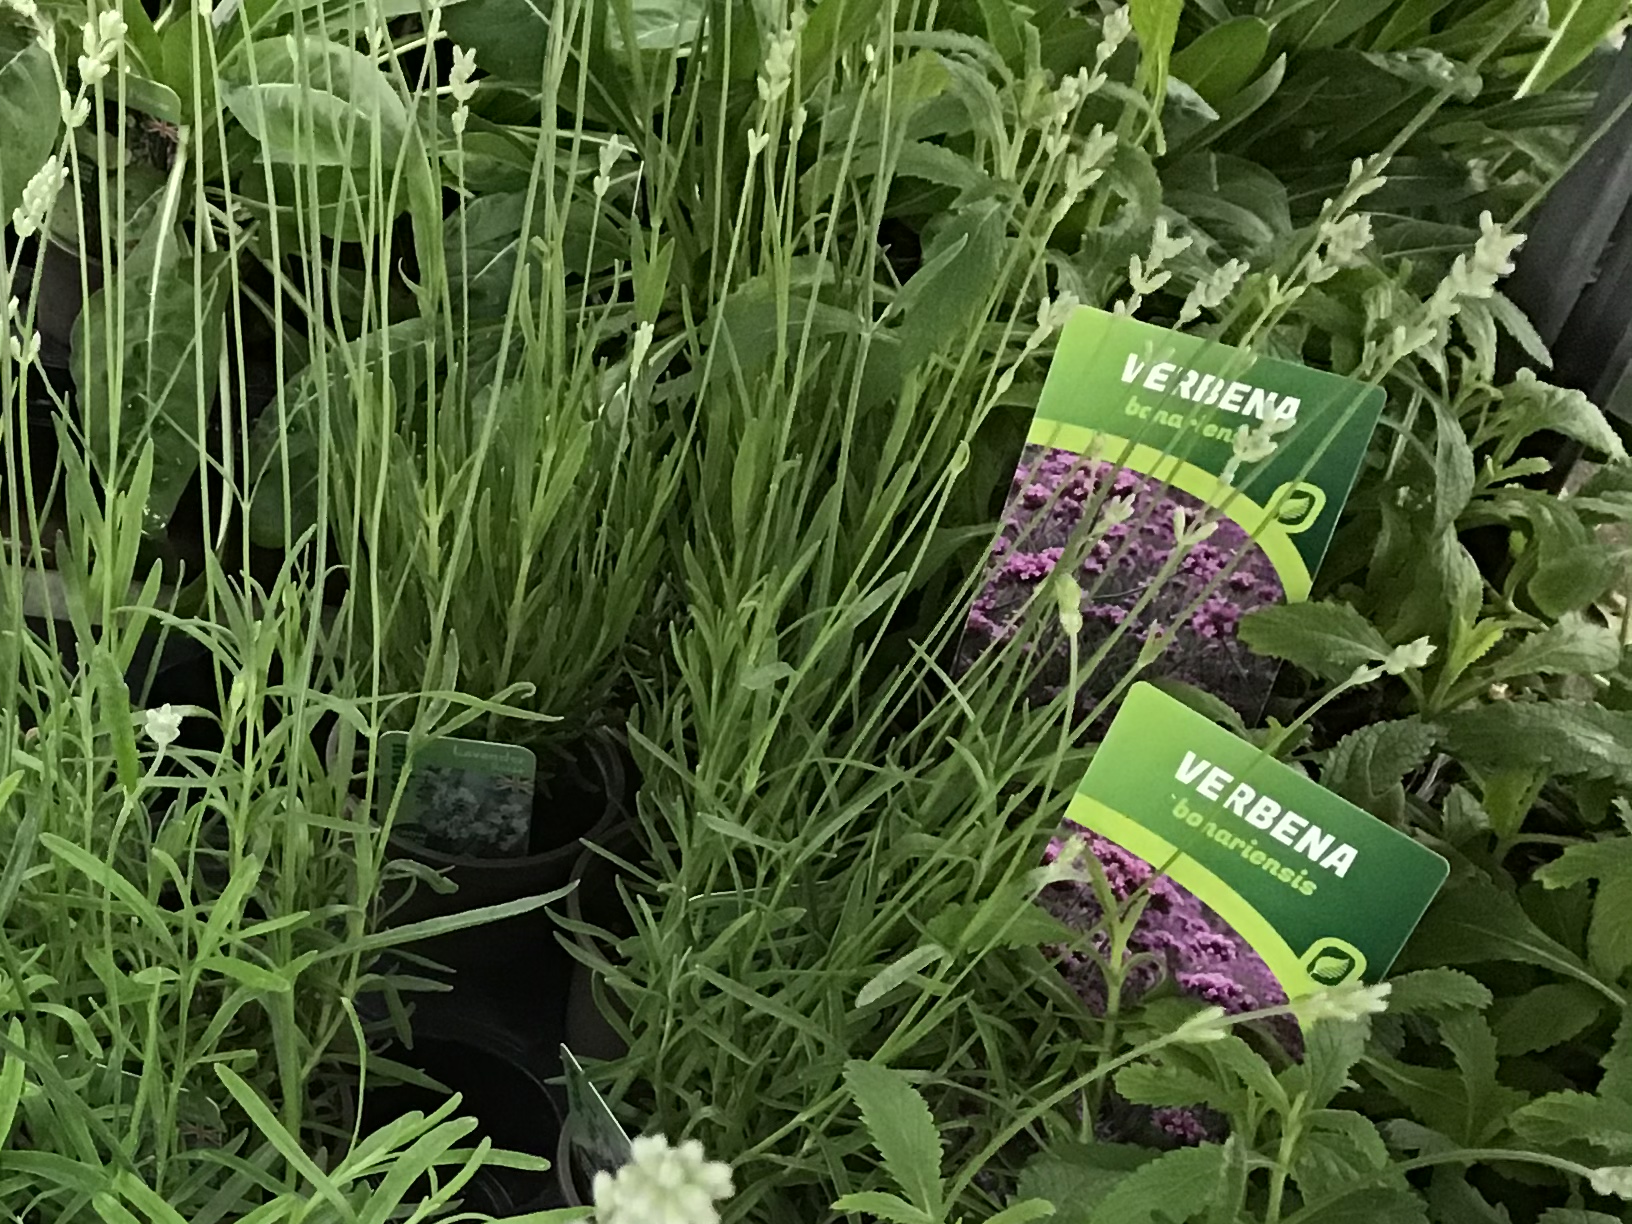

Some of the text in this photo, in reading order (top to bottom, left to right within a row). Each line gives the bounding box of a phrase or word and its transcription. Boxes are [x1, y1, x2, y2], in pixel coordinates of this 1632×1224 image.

[1121, 353, 1301, 419] VERBENA
[1172, 797, 1318, 896] bonariensis
[1174, 750, 1359, 879] VERBENA
